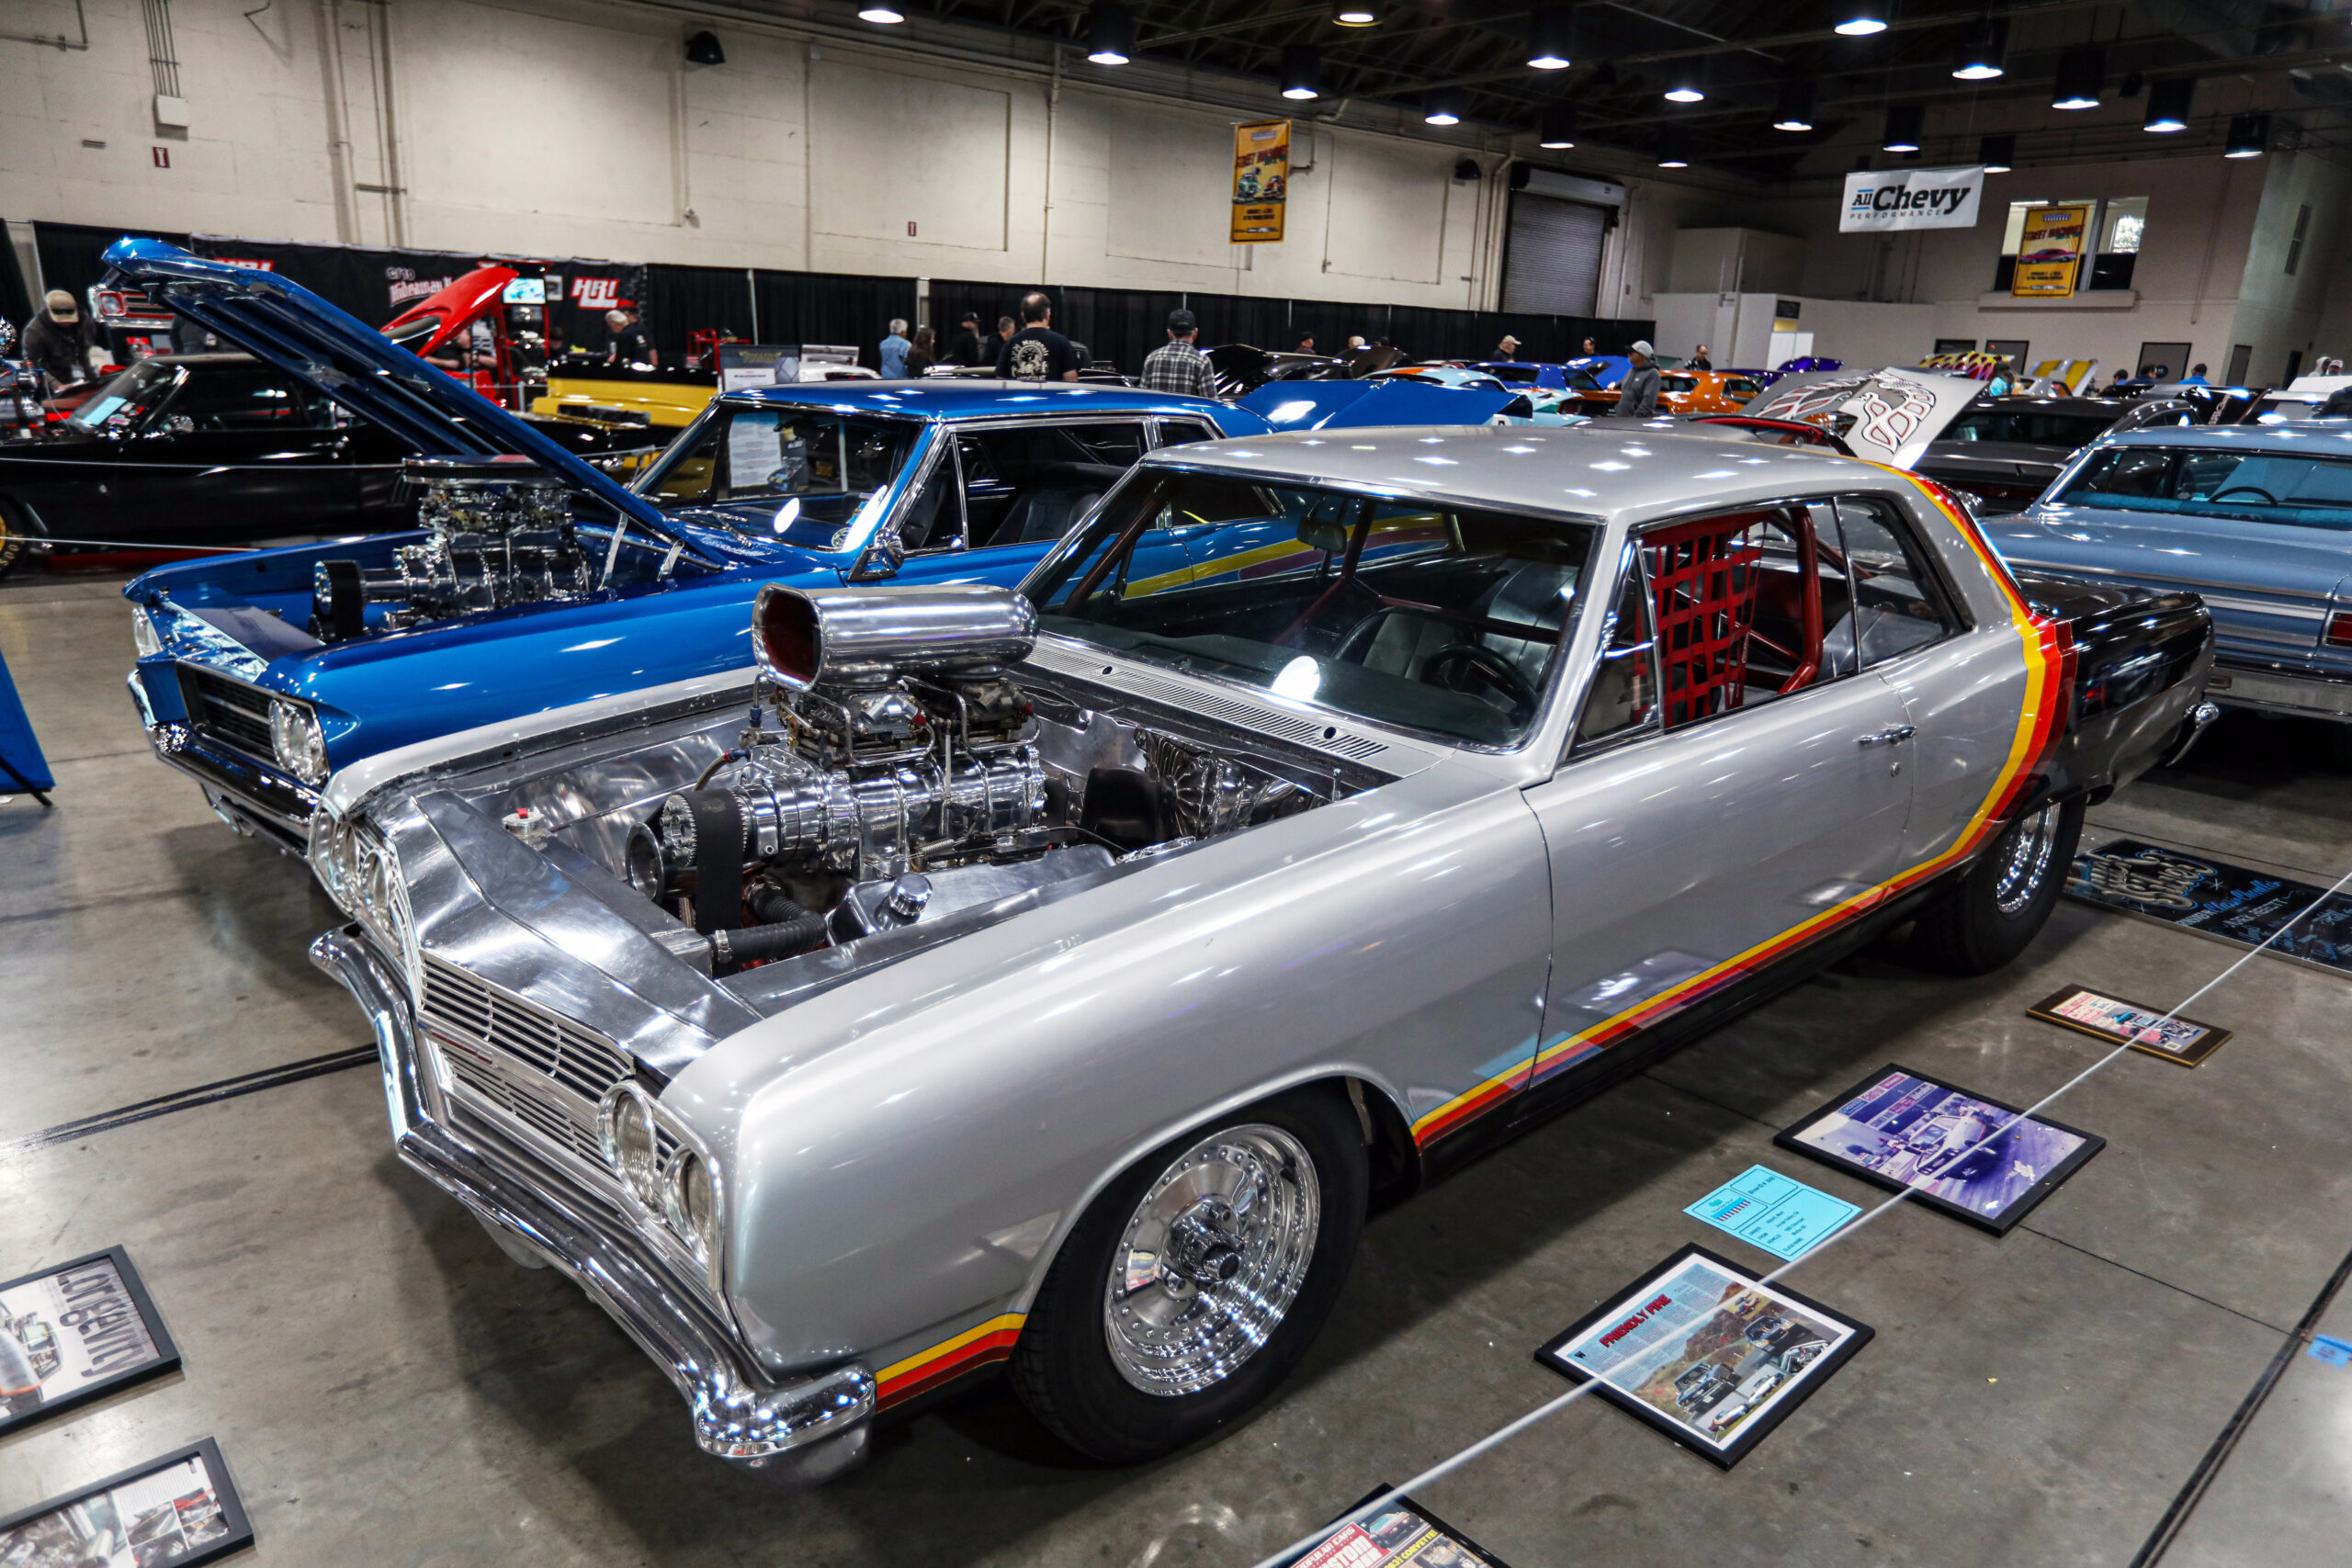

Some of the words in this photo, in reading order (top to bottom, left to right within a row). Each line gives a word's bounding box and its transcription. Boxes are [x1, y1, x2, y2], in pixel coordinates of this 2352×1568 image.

[1850, 209, 1940, 220] PERFORMANCE
[1872, 185, 1971, 215] Chevy
[1599, 1310, 1649, 1348] FRIENDLY
[1644, 1293, 1672, 1319] FIRE
